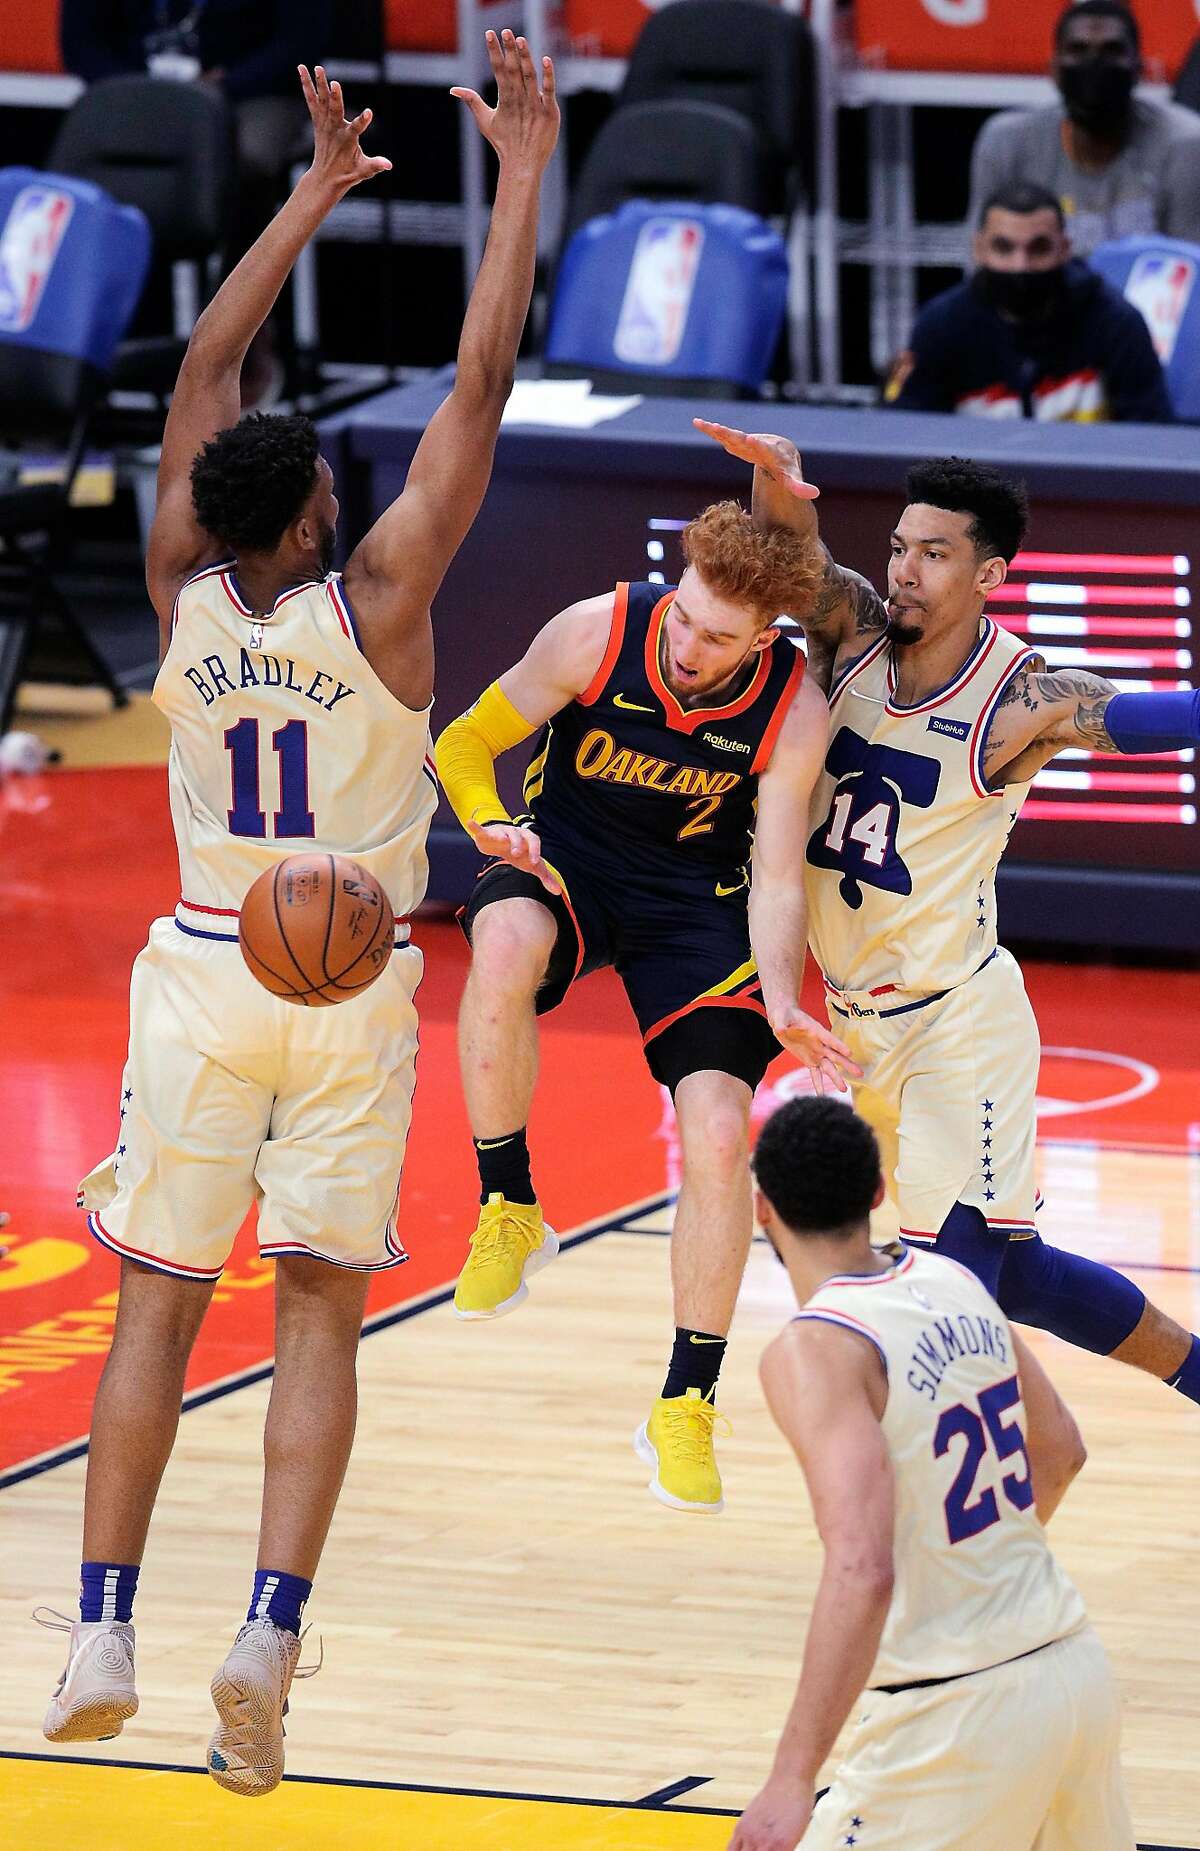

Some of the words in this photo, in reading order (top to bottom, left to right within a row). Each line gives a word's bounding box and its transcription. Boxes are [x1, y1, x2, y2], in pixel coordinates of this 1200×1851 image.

[184, 648, 355, 711] BRADLEY
[575, 728, 743, 795] OAKLAND
[703, 732, 751, 754] Rakuten
[932, 720, 965, 736] StubHub
[224, 718, 315, 838] 11
[677, 795, 723, 841] 2
[826, 793, 891, 867] 14
[907, 1315, 1007, 1401] SIMMONS
[933, 1375, 1034, 1545] 25
